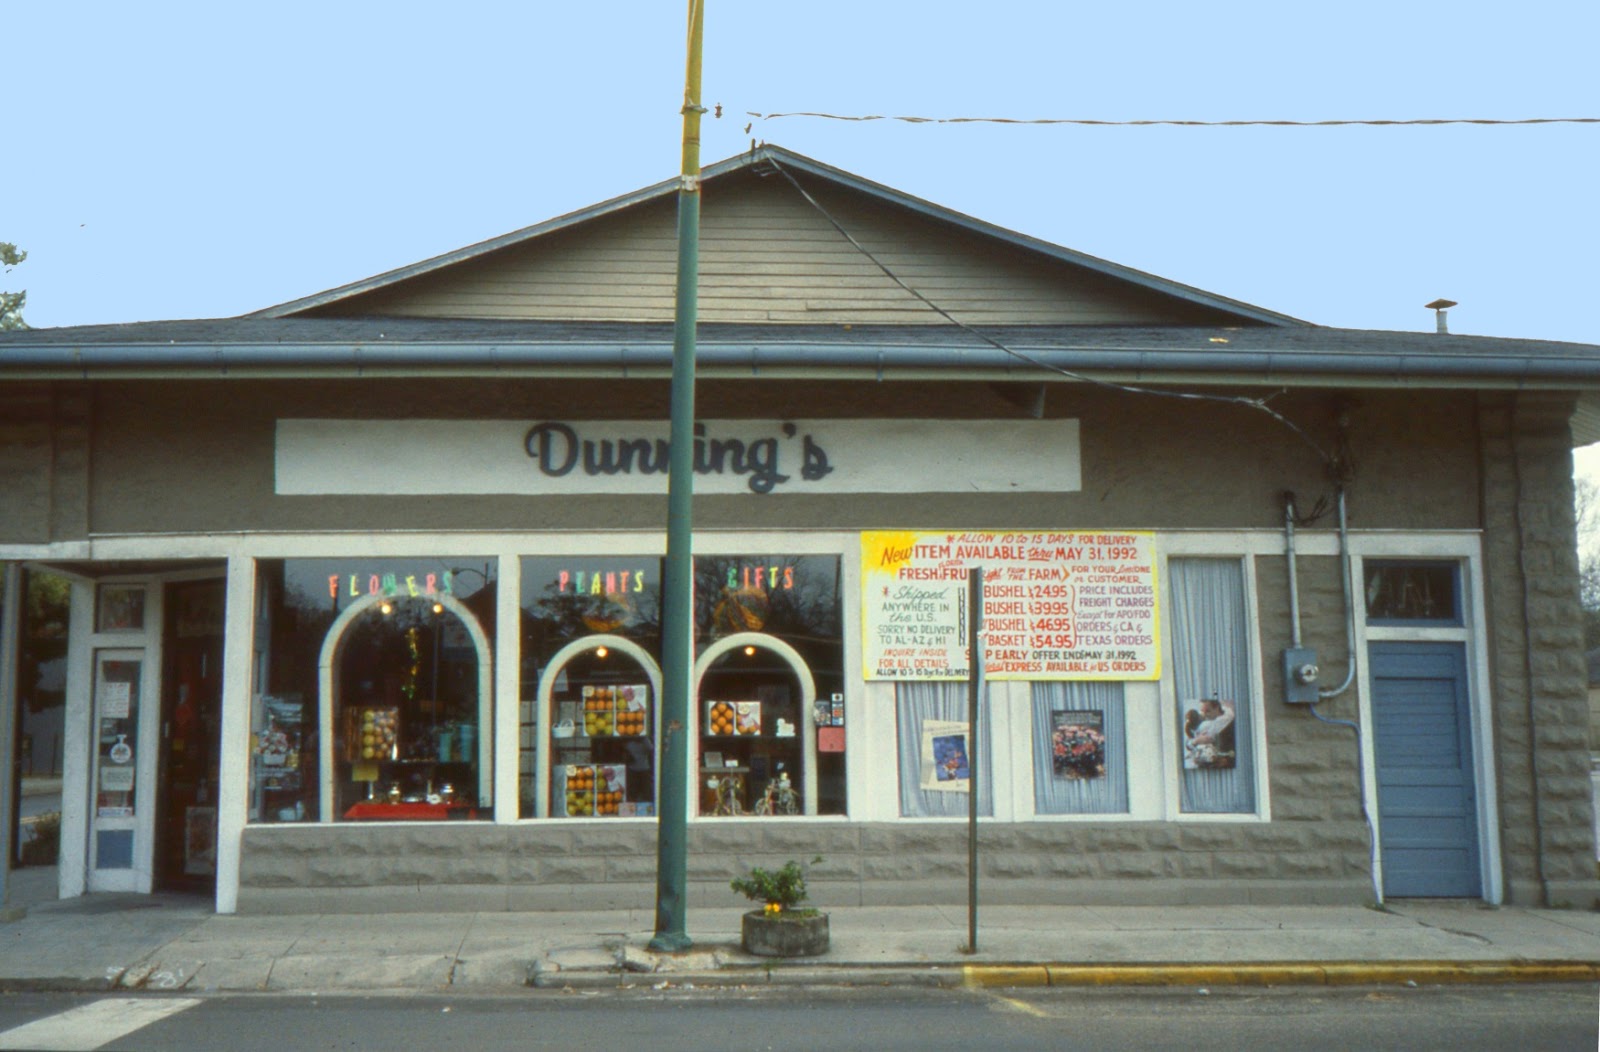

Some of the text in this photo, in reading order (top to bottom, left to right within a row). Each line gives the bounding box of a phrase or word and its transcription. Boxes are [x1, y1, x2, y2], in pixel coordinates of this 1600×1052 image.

[957, 534, 1137, 545] ALLOW 10 to 15 DAYS FOR DELIVERY
[880, 547, 913, 566] New
[915, 545, 950, 559] ITEM
[956, 546, 1025, 560] AVAILABLE
[1055, 548, 1083, 560] MAY
[899, 568, 938, 580] FRESH
[943, 568, 969, 580] FRU
[1028, 568, 1062, 580] FARM
[1072, 565, 1089, 573] FOR
[1092, 565, 1116, 573] YOUR
[559, 569, 644, 594] PLANTS
[727, 567, 794, 590] GIFTS
[1087, 575, 1142, 584] CUSTOMER
[328, 571, 453, 598] FLOWERS
[893, 585, 949, 604] Shipped
[983, 585, 1026, 598] BUSHEL
[1079, 585, 1154, 595] PRICE INCLUDES
[881, 602, 950, 612] ANYWHERE IN
[1079, 597, 1155, 607] FREIGHT CHARGES
[985, 602, 1025, 615] BUSHEL
[877, 625, 956, 634] SORRY NO DELIVERY
[988, 618, 1027, 631] BUSHEL
[1076, 622, 1112, 632] ORDERS
[1119, 622, 1134, 631] CA
[879, 635, 892, 644] TO
[935, 636, 946, 644] HI
[988, 634, 1026, 646] BASKET
[1077, 635, 1153, 646] TEXAS ORDERS
[884, 648, 915, 657] INQUIRE
[995, 650, 1028, 660] EARLY
[1032, 650, 1060, 660] OFFER
[1085, 651, 1103, 660] MAY
[878, 659, 949, 668] FOR ALL DETAILS
[1005, 662, 1042, 672] EXPRESS
[1046, 662, 1088, 672] AVAILABLE
[1111, 662, 1147, 672] ORDERS
[876, 668, 898, 676] ALLOW
